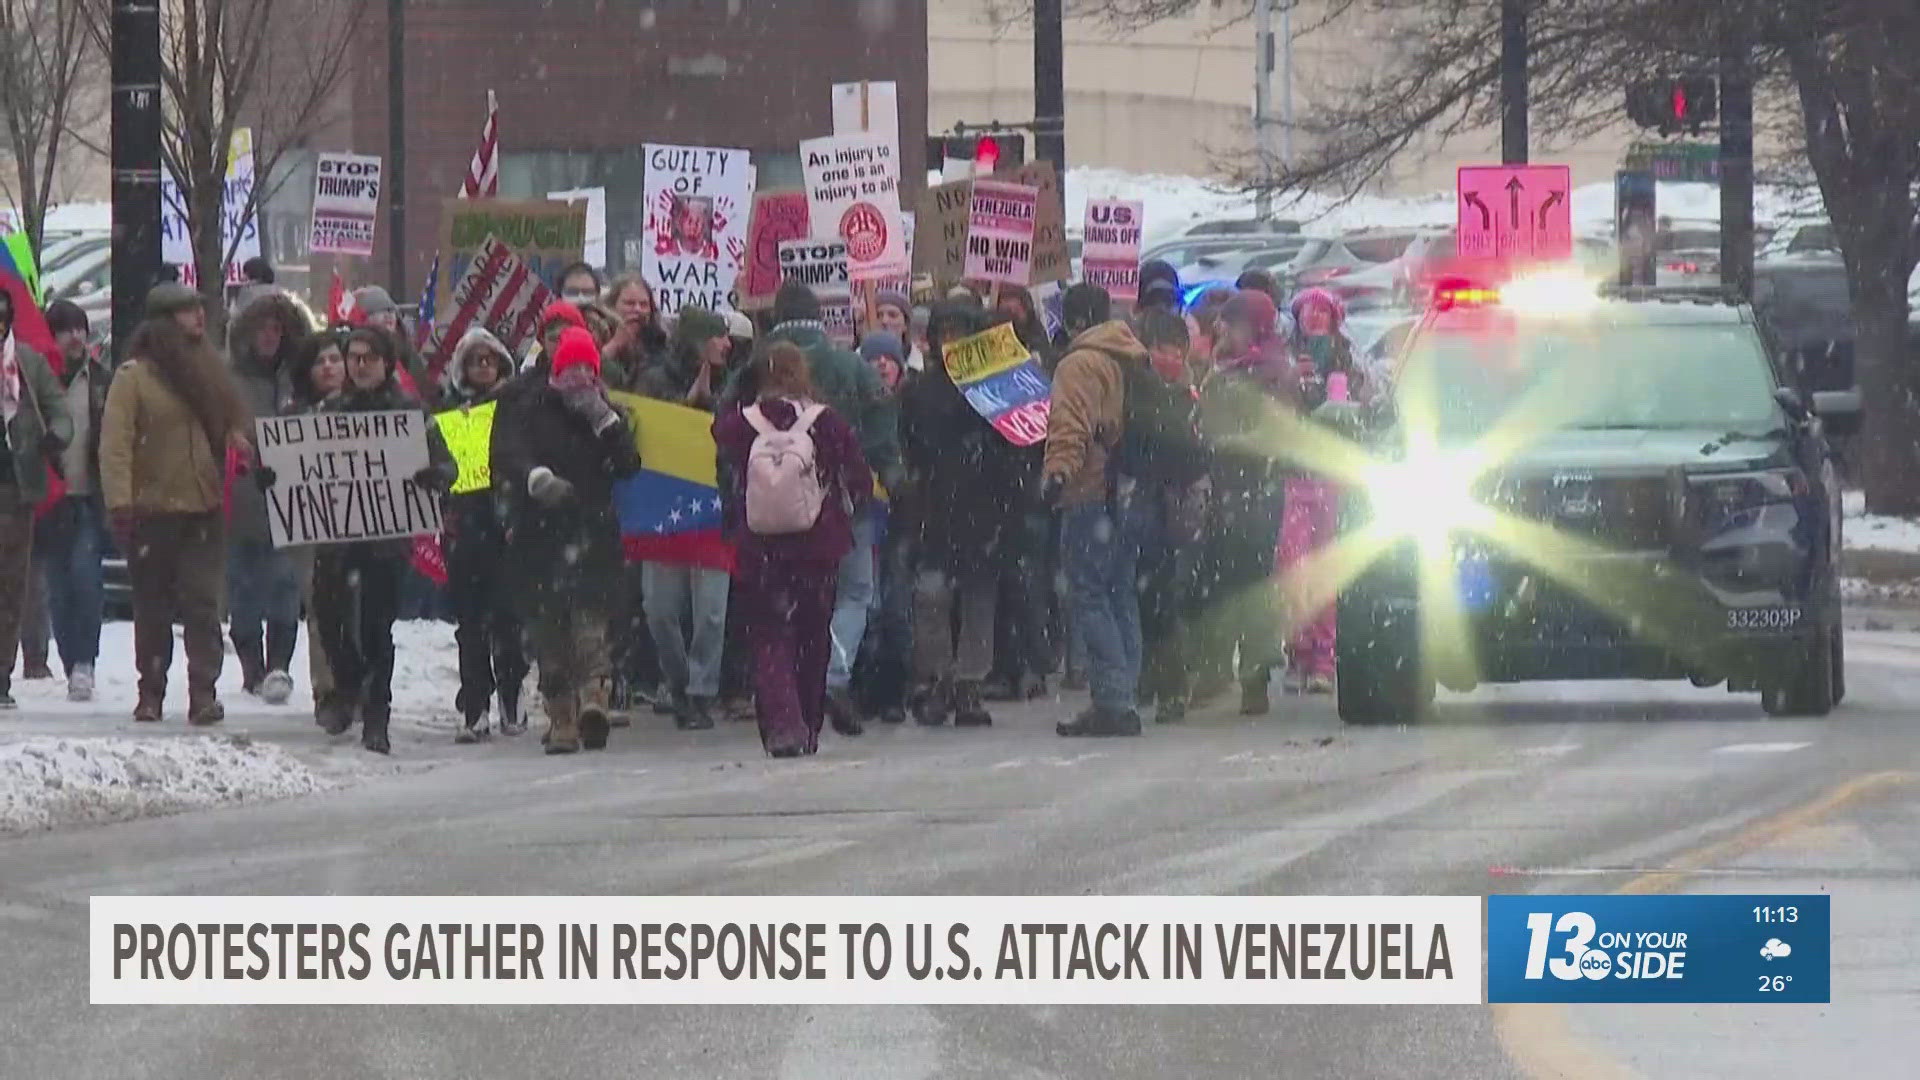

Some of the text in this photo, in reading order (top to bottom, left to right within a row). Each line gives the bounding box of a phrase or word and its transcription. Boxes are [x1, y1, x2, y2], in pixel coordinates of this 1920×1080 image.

[652, 149, 728, 176] GUILTY
[808, 145, 890, 167] An injury to
[320, 161, 379, 175] STOP
[822, 163, 885, 183] one is an
[318, 176, 379, 199] TRUMP'S
[674, 177, 702, 193] OF
[814, 178, 895, 203] injury to all
[1092, 205, 1135, 225] U.S.
[1084, 226, 1118, 244] HANDS
[1120, 228, 1140, 245] OFF
[780, 244, 846, 262] STOP
[969, 235, 989, 258] NO
[995, 238, 1030, 262] WAR
[658, 261, 718, 287] WAR
[985, 257, 1012, 274] WITH
[263, 417, 304, 447] NO
[300, 450, 388, 482] WITH
